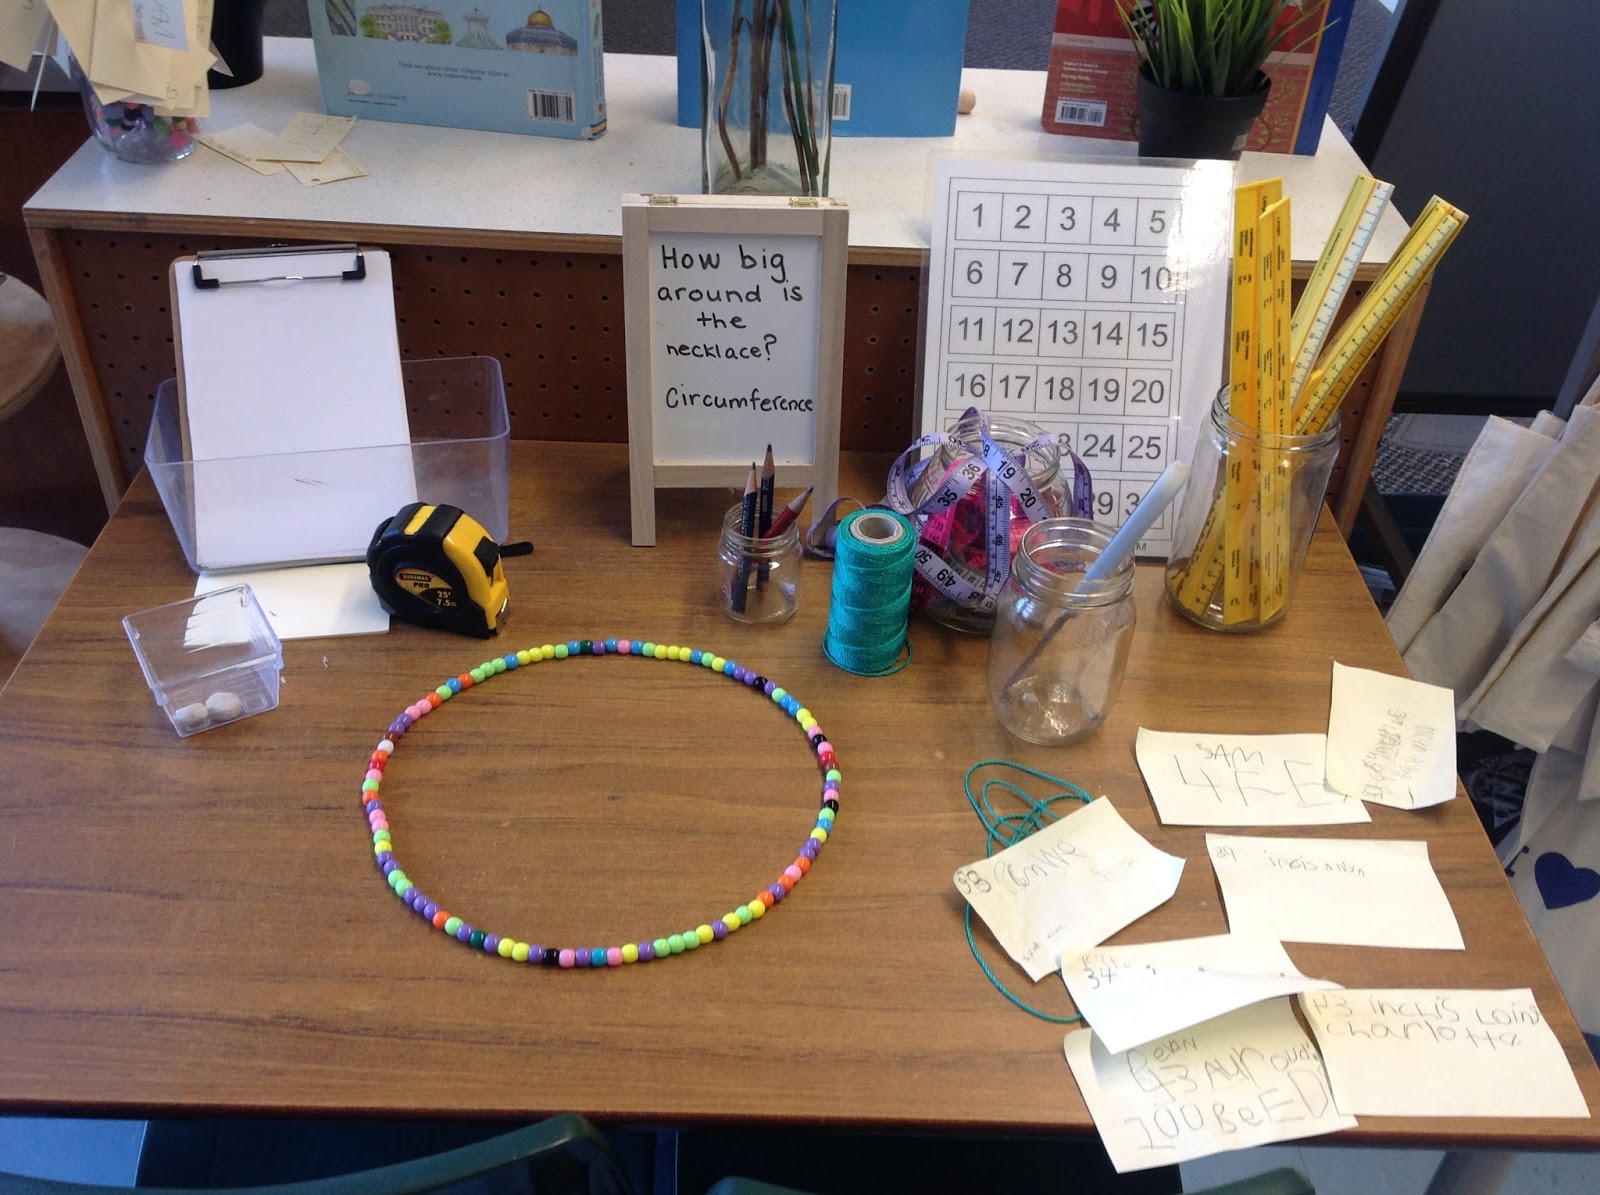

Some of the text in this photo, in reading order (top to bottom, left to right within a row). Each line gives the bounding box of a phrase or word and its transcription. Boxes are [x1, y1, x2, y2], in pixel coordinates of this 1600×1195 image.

[972, 203, 1166, 234] 1 2 3 4 5
[661, 244, 787, 284] How big
[967, 260, 1172, 290] 6 7 8 9 10
[657, 280, 803, 303] around is
[696, 311, 747, 330] the
[958, 317, 1168, 347] 11 12 13 14 15
[666, 333, 778, 361] necklace?
[665, 383, 814, 412] Circumference
[954, 373, 1165, 404] 16 17 18 19 20
[1082, 434, 1116, 458] 24
[1127, 435, 1162, 460] 25
[937, 463, 981, 508] 35 36
[1019, 487, 1037, 508] 20
